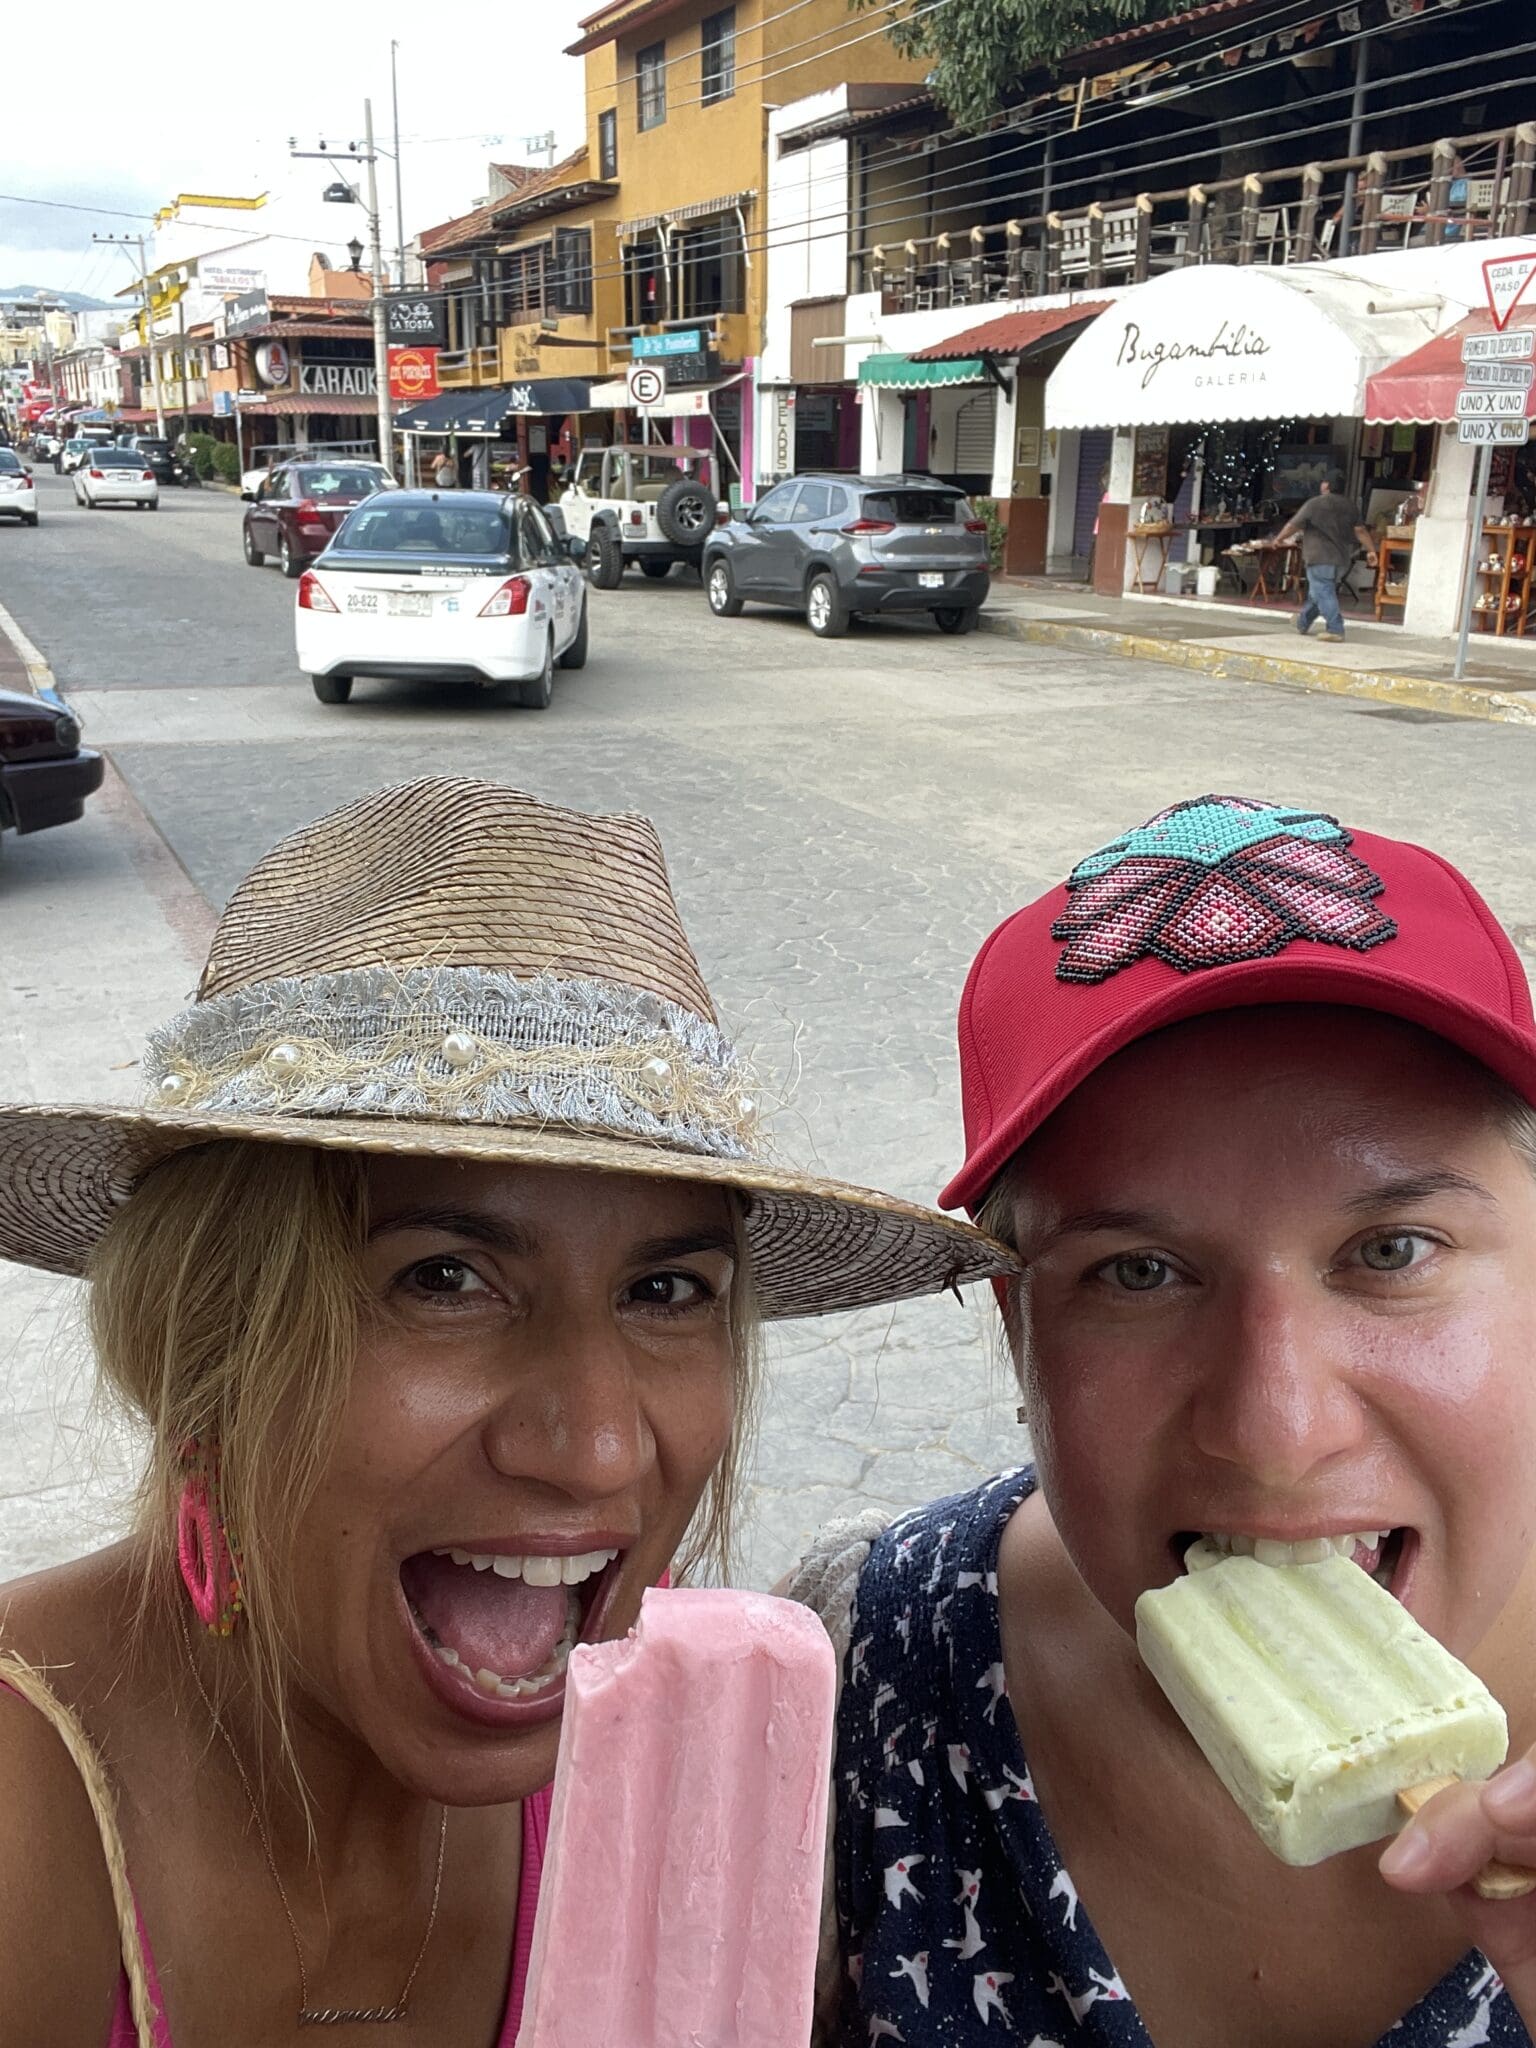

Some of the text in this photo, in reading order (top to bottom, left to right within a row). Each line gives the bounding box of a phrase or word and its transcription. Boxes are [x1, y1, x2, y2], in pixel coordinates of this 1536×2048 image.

[1491, 264, 1529, 278] CEDA EL
[1494, 280, 1520, 293] PASO
[1117, 320, 1271, 389] Bugambilia
[1465, 340, 1488, 356] PRIMERO
[1498, 337, 1523, 354] DESPUES
[300, 365, 378, 395] KARAOK
[1194, 371, 1267, 388] GALERIA
[1468, 365, 1491, 381] PRIMERO
[1499, 367, 1523, 383] DESPUES
[639, 375, 653, 397] E
[1460, 394, 1521, 412] UNO X UNO
[777, 393, 788, 470] HELADOS
[1462, 422, 1524, 440] UNO X UNO
[347, 594, 378, 608] 20-822
